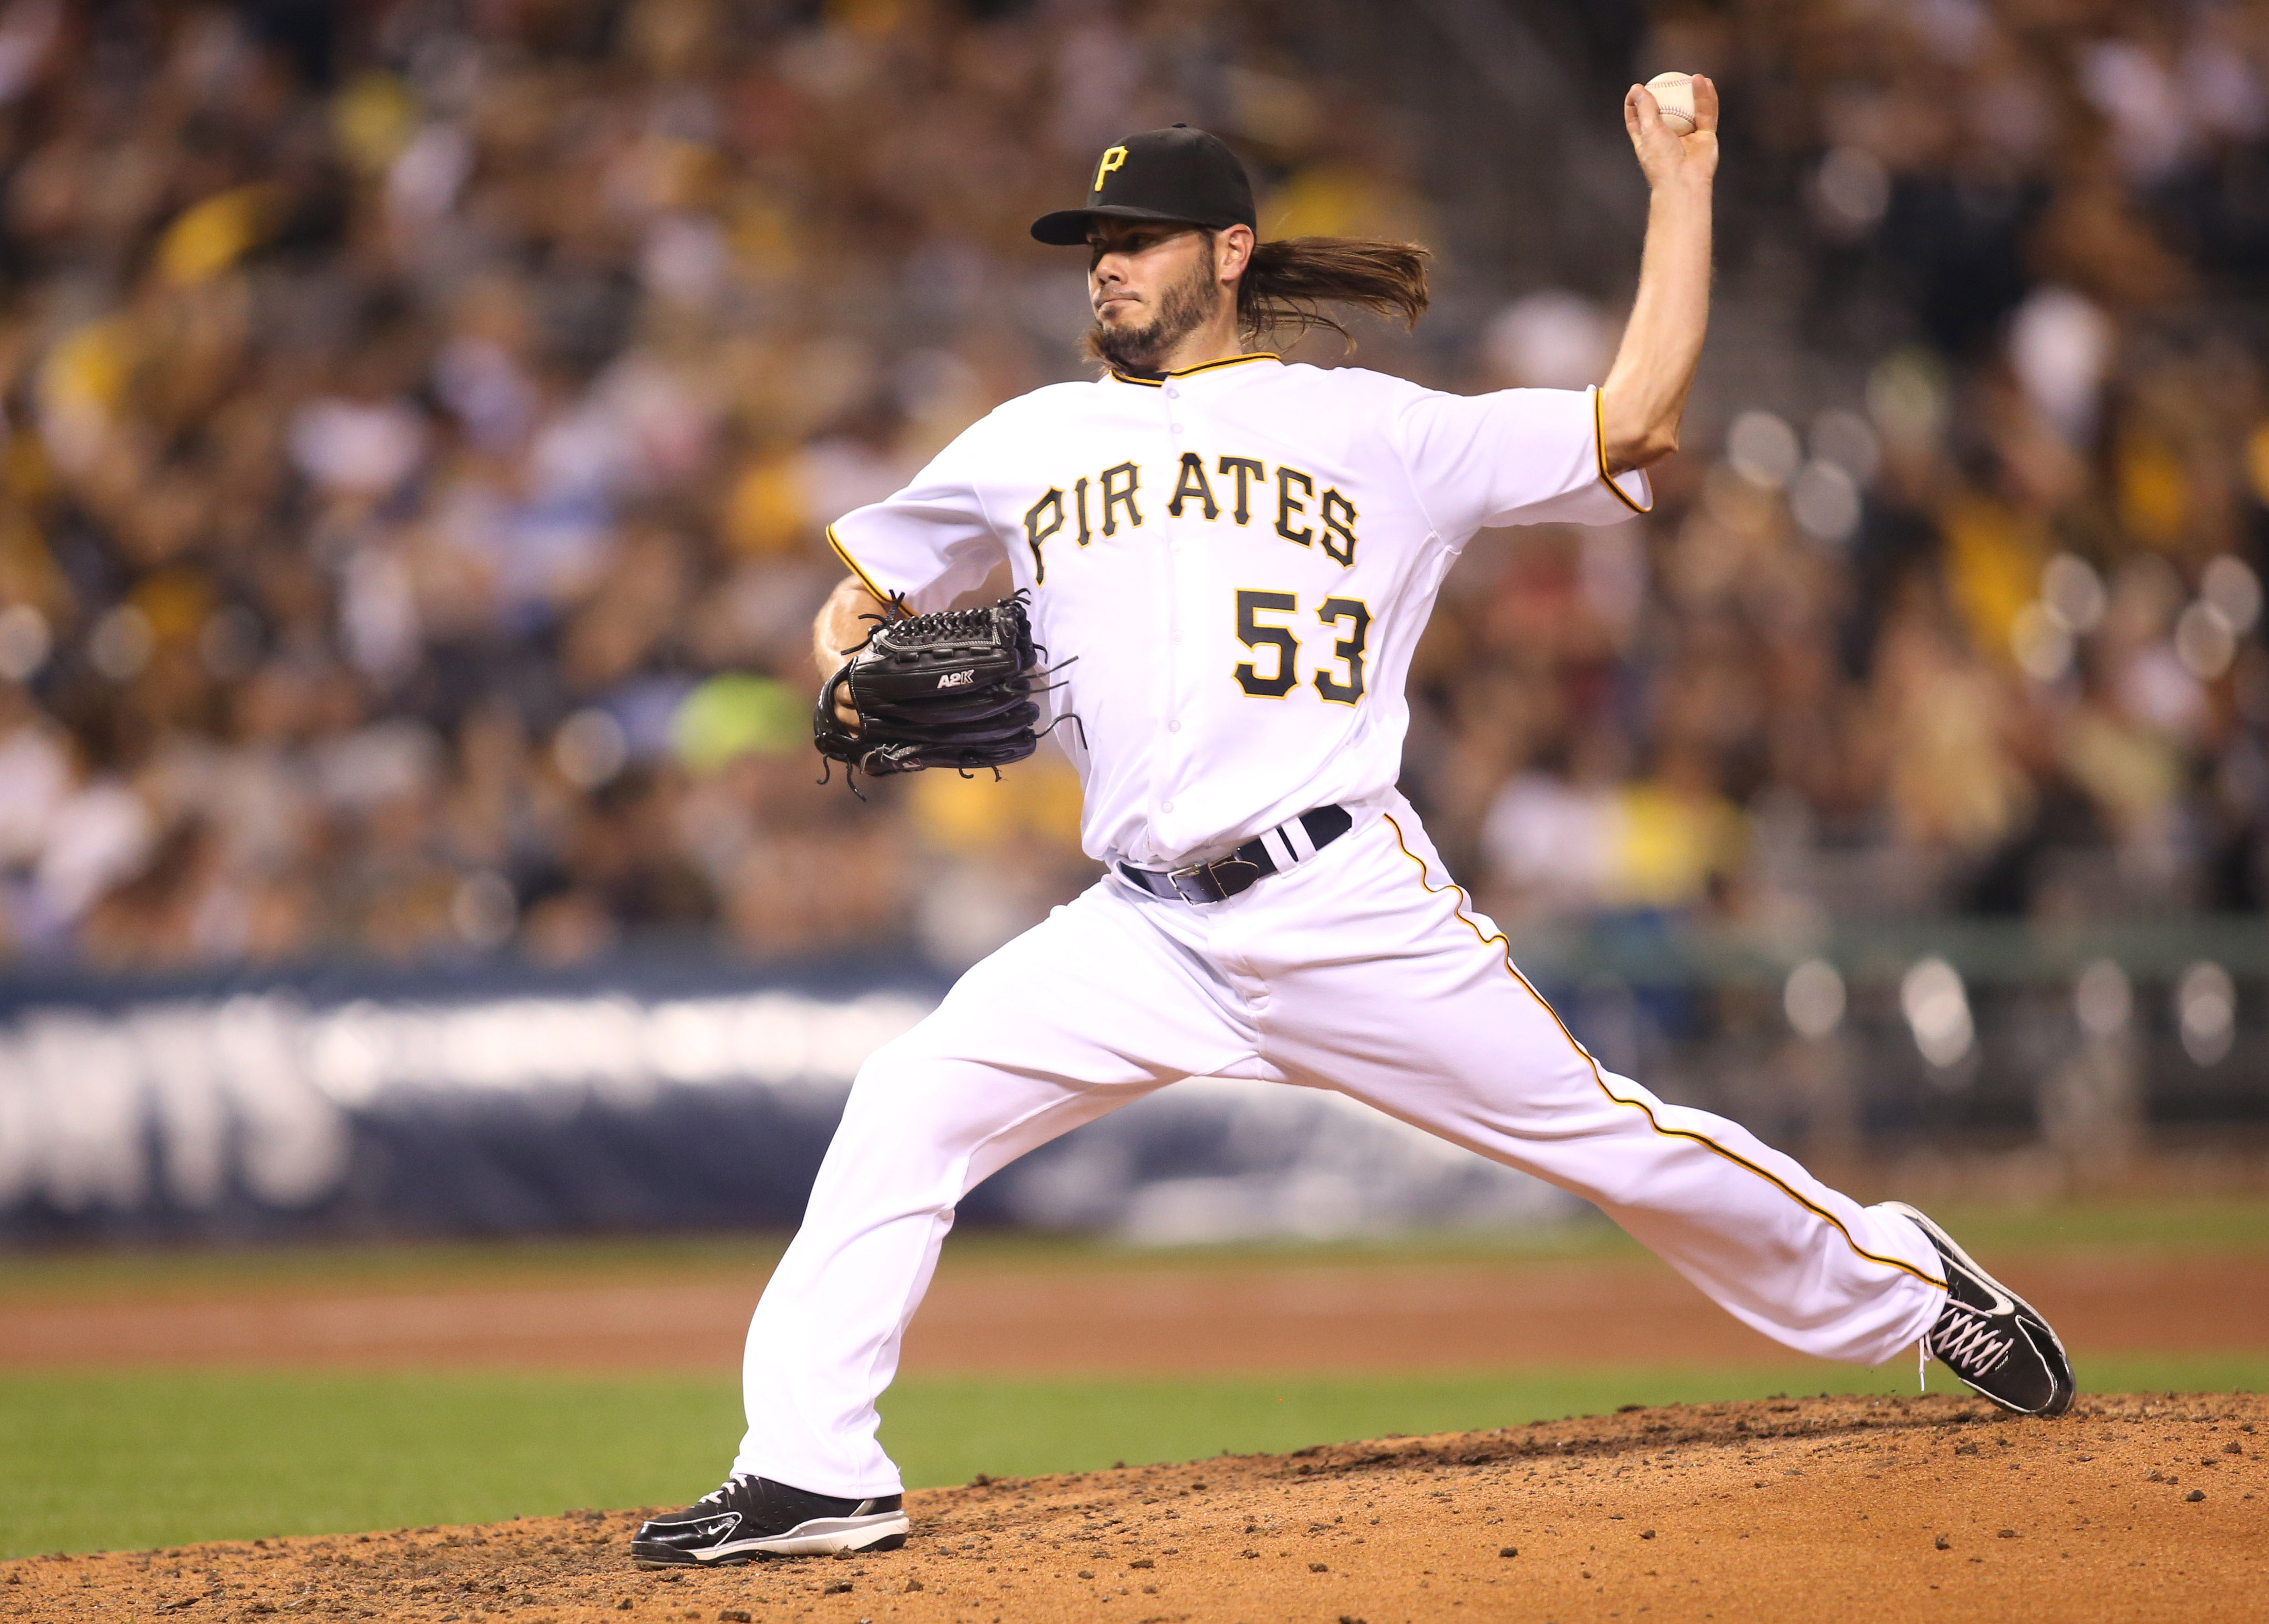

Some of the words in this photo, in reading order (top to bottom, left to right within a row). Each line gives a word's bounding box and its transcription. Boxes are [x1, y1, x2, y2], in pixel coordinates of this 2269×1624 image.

[1094, 146, 1129, 192] P
[1023, 451, 1360, 588] PIRATES
[937, 669, 974, 689] A2K
[1231, 587, 1374, 708] 53
